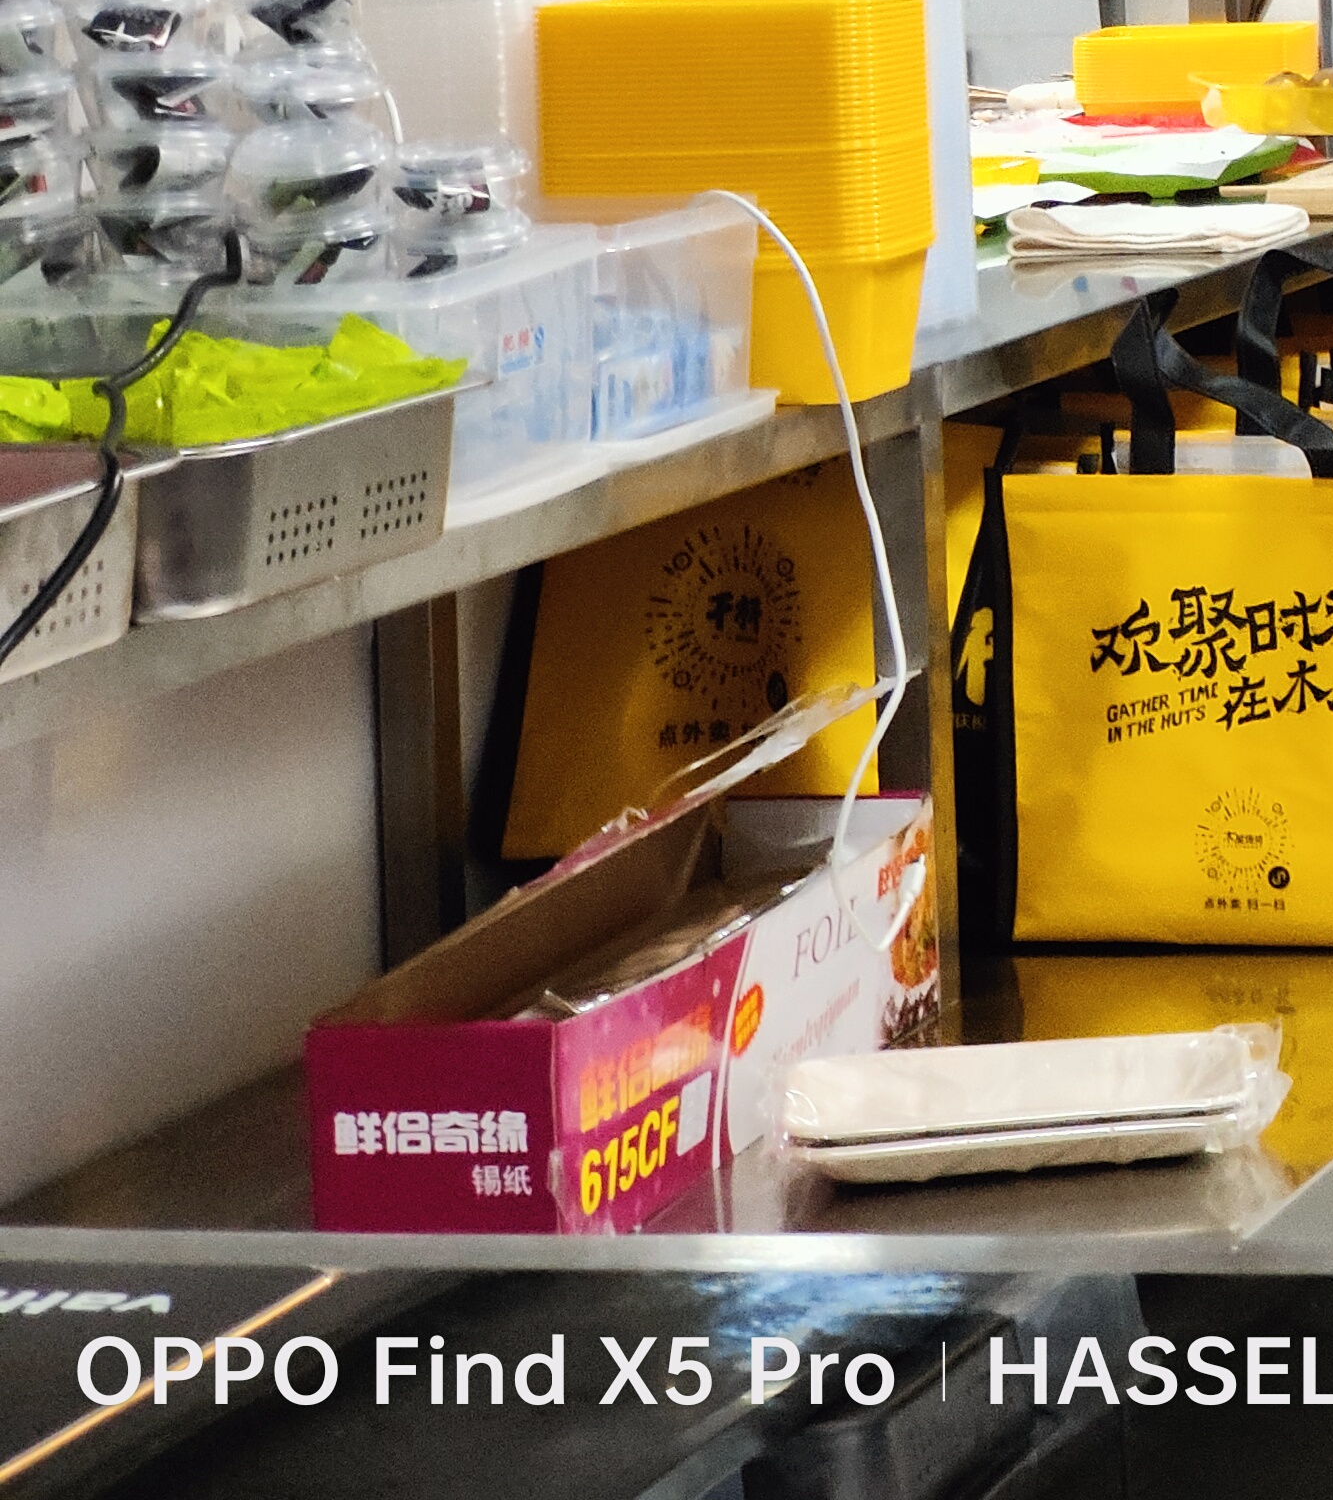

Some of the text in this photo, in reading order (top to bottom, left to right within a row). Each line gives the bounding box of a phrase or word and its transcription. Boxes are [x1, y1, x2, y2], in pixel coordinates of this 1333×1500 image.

[1106, 681, 1219, 723] GATHER TIME
[1107, 725, 1122, 743] IN
[1126, 716, 1156, 739] THE
[334, 1110, 528, 1155] 鲜侣奇缘
[580, 1095, 680, 1216] 615CF
[471, 1164, 533, 1198] 锡纸
